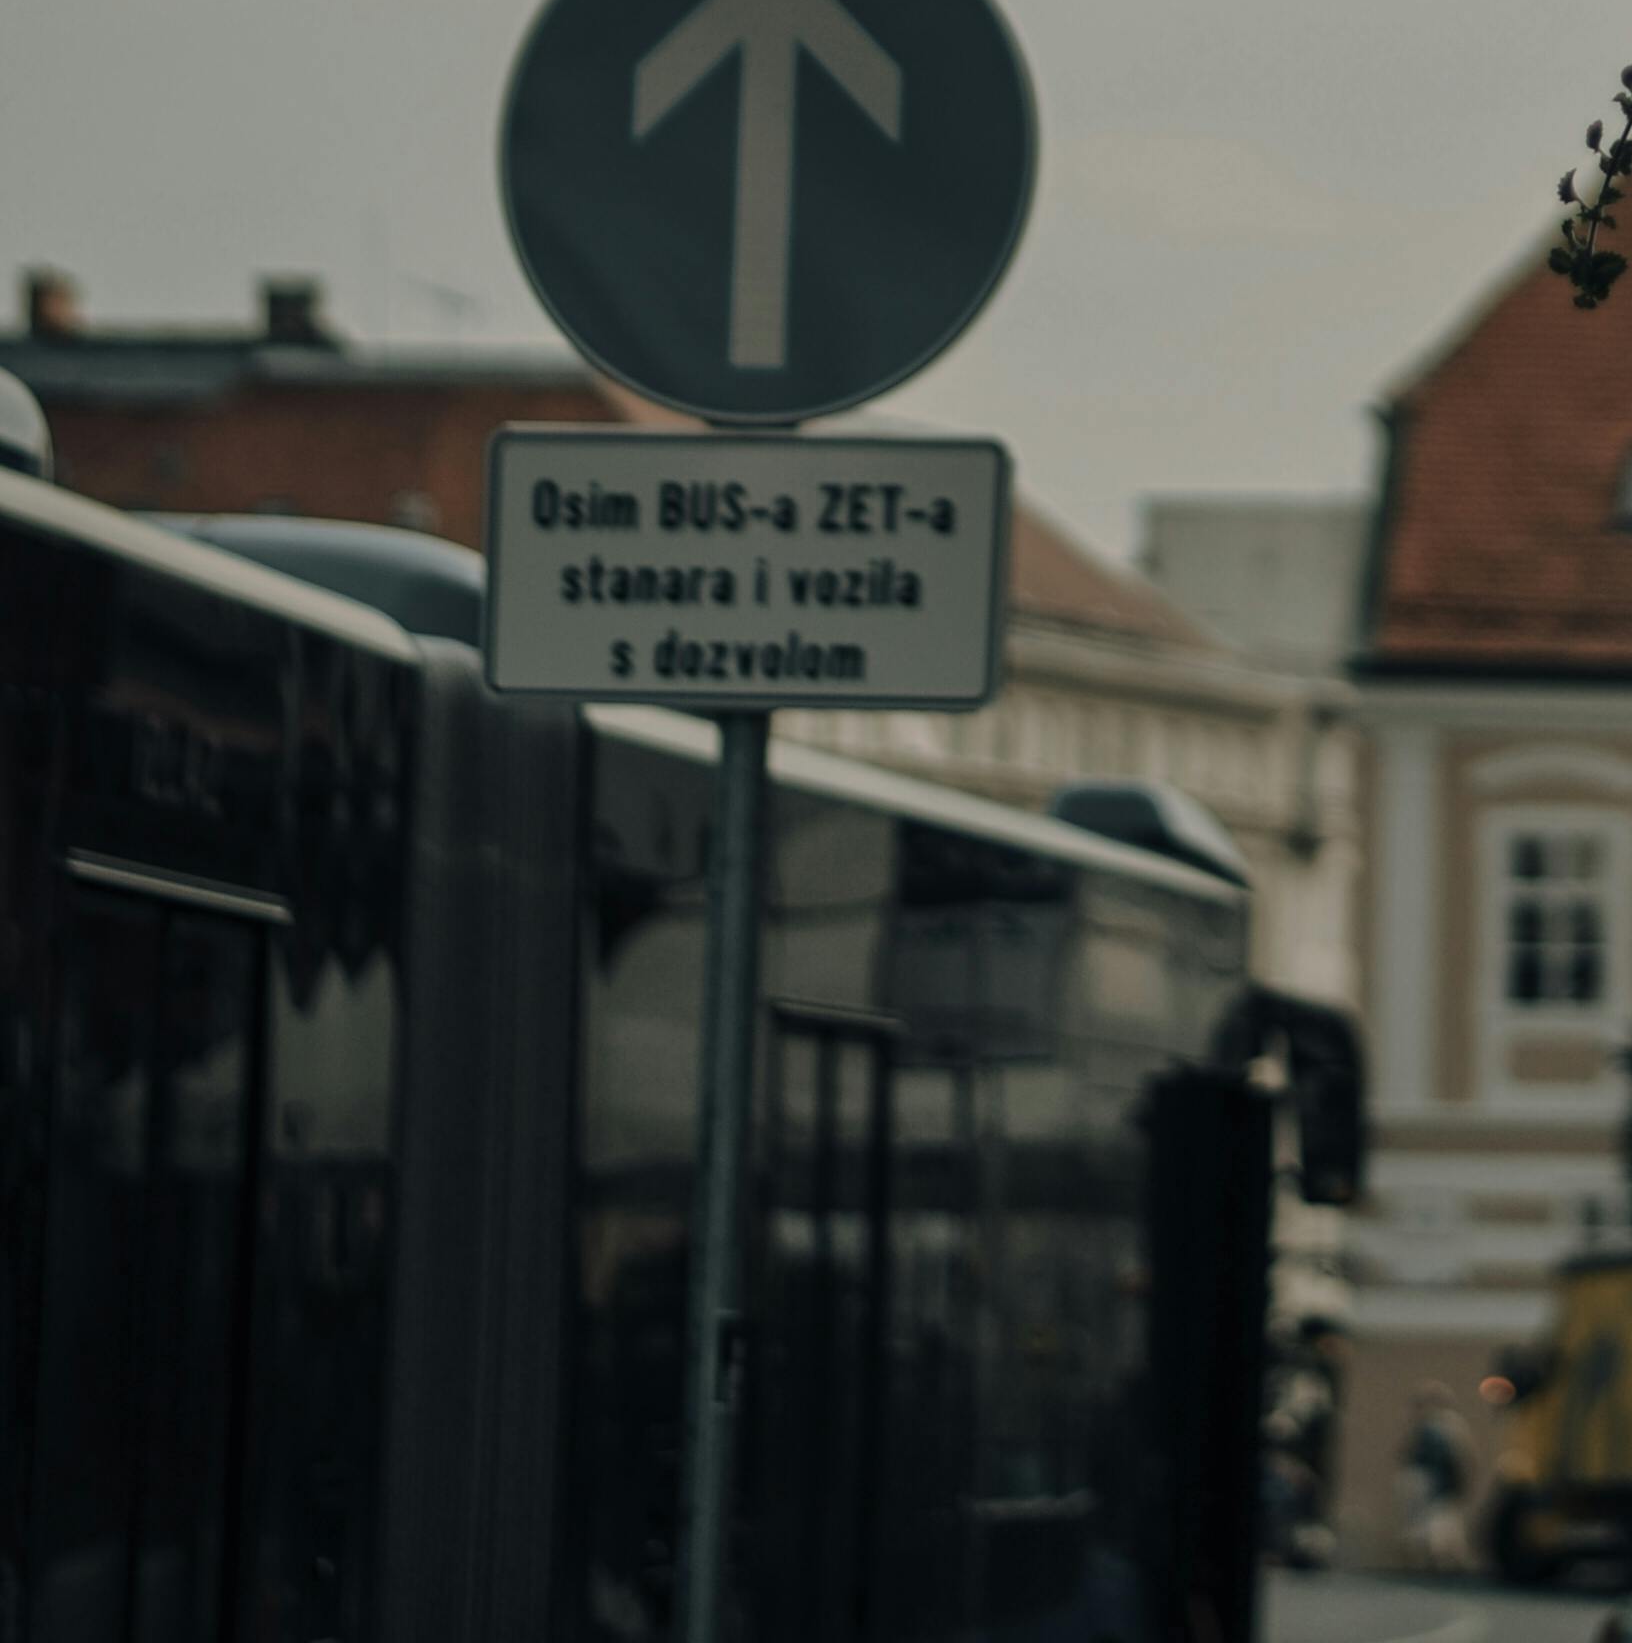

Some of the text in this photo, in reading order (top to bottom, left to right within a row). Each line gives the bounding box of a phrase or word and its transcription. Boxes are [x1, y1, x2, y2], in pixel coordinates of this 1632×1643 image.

[532, 479, 957, 534] Osim BUS-a ZET-a
[561, 557, 921, 609] stanara i vozila
[609, 629, 867, 680] s dozvolom
